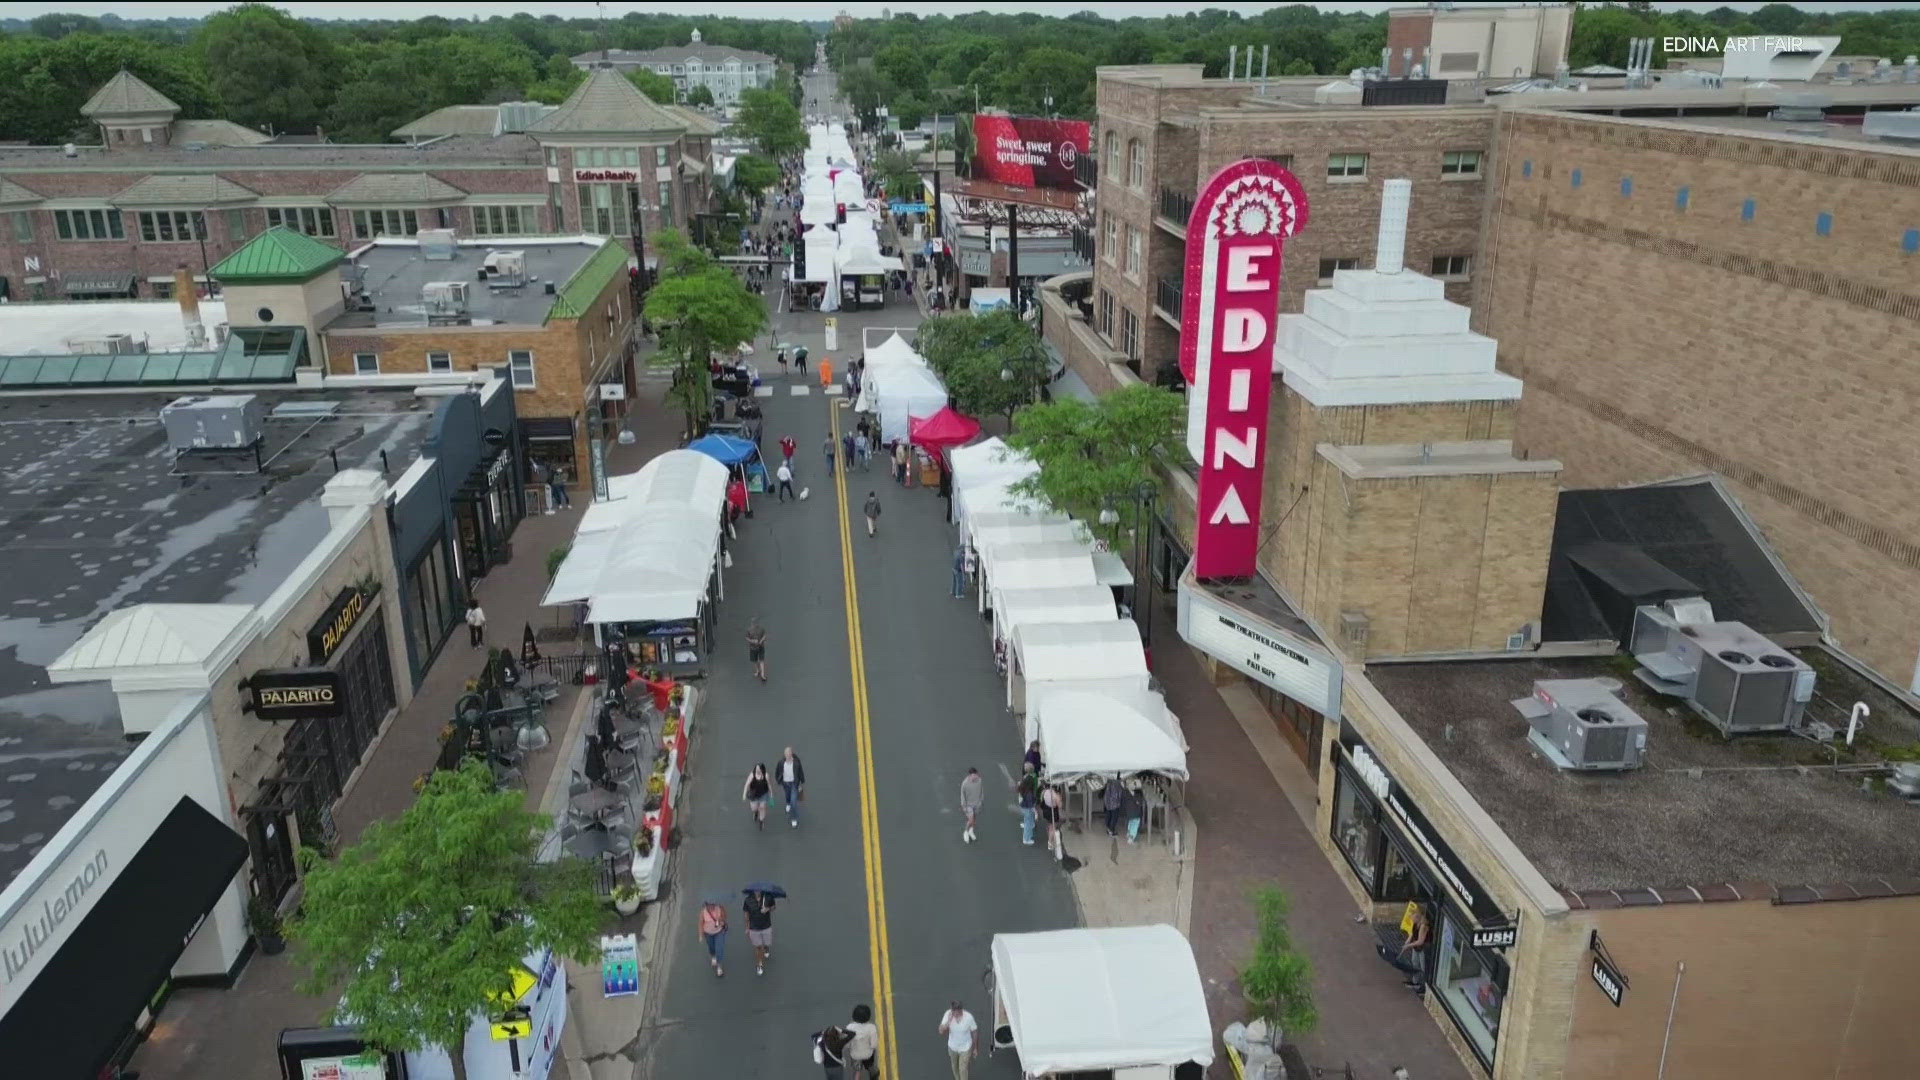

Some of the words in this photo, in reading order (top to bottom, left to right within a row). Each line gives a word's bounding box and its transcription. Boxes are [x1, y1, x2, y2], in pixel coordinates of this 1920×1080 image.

[996, 136, 1025, 152] Sweet,
[1026, 141, 1052, 153] sweet
[575, 170, 604, 181] Edina
[604, 170, 637, 183] Realty
[1208, 243, 1274, 526] EDINA
[322, 592, 363, 657] PAJARITO
[260, 688, 334, 705] PAJARITO
[3, 848, 109, 984] lululemon
[1473, 930, 1515, 945] LUSH
[1593, 962, 1619, 1002] LUSH
